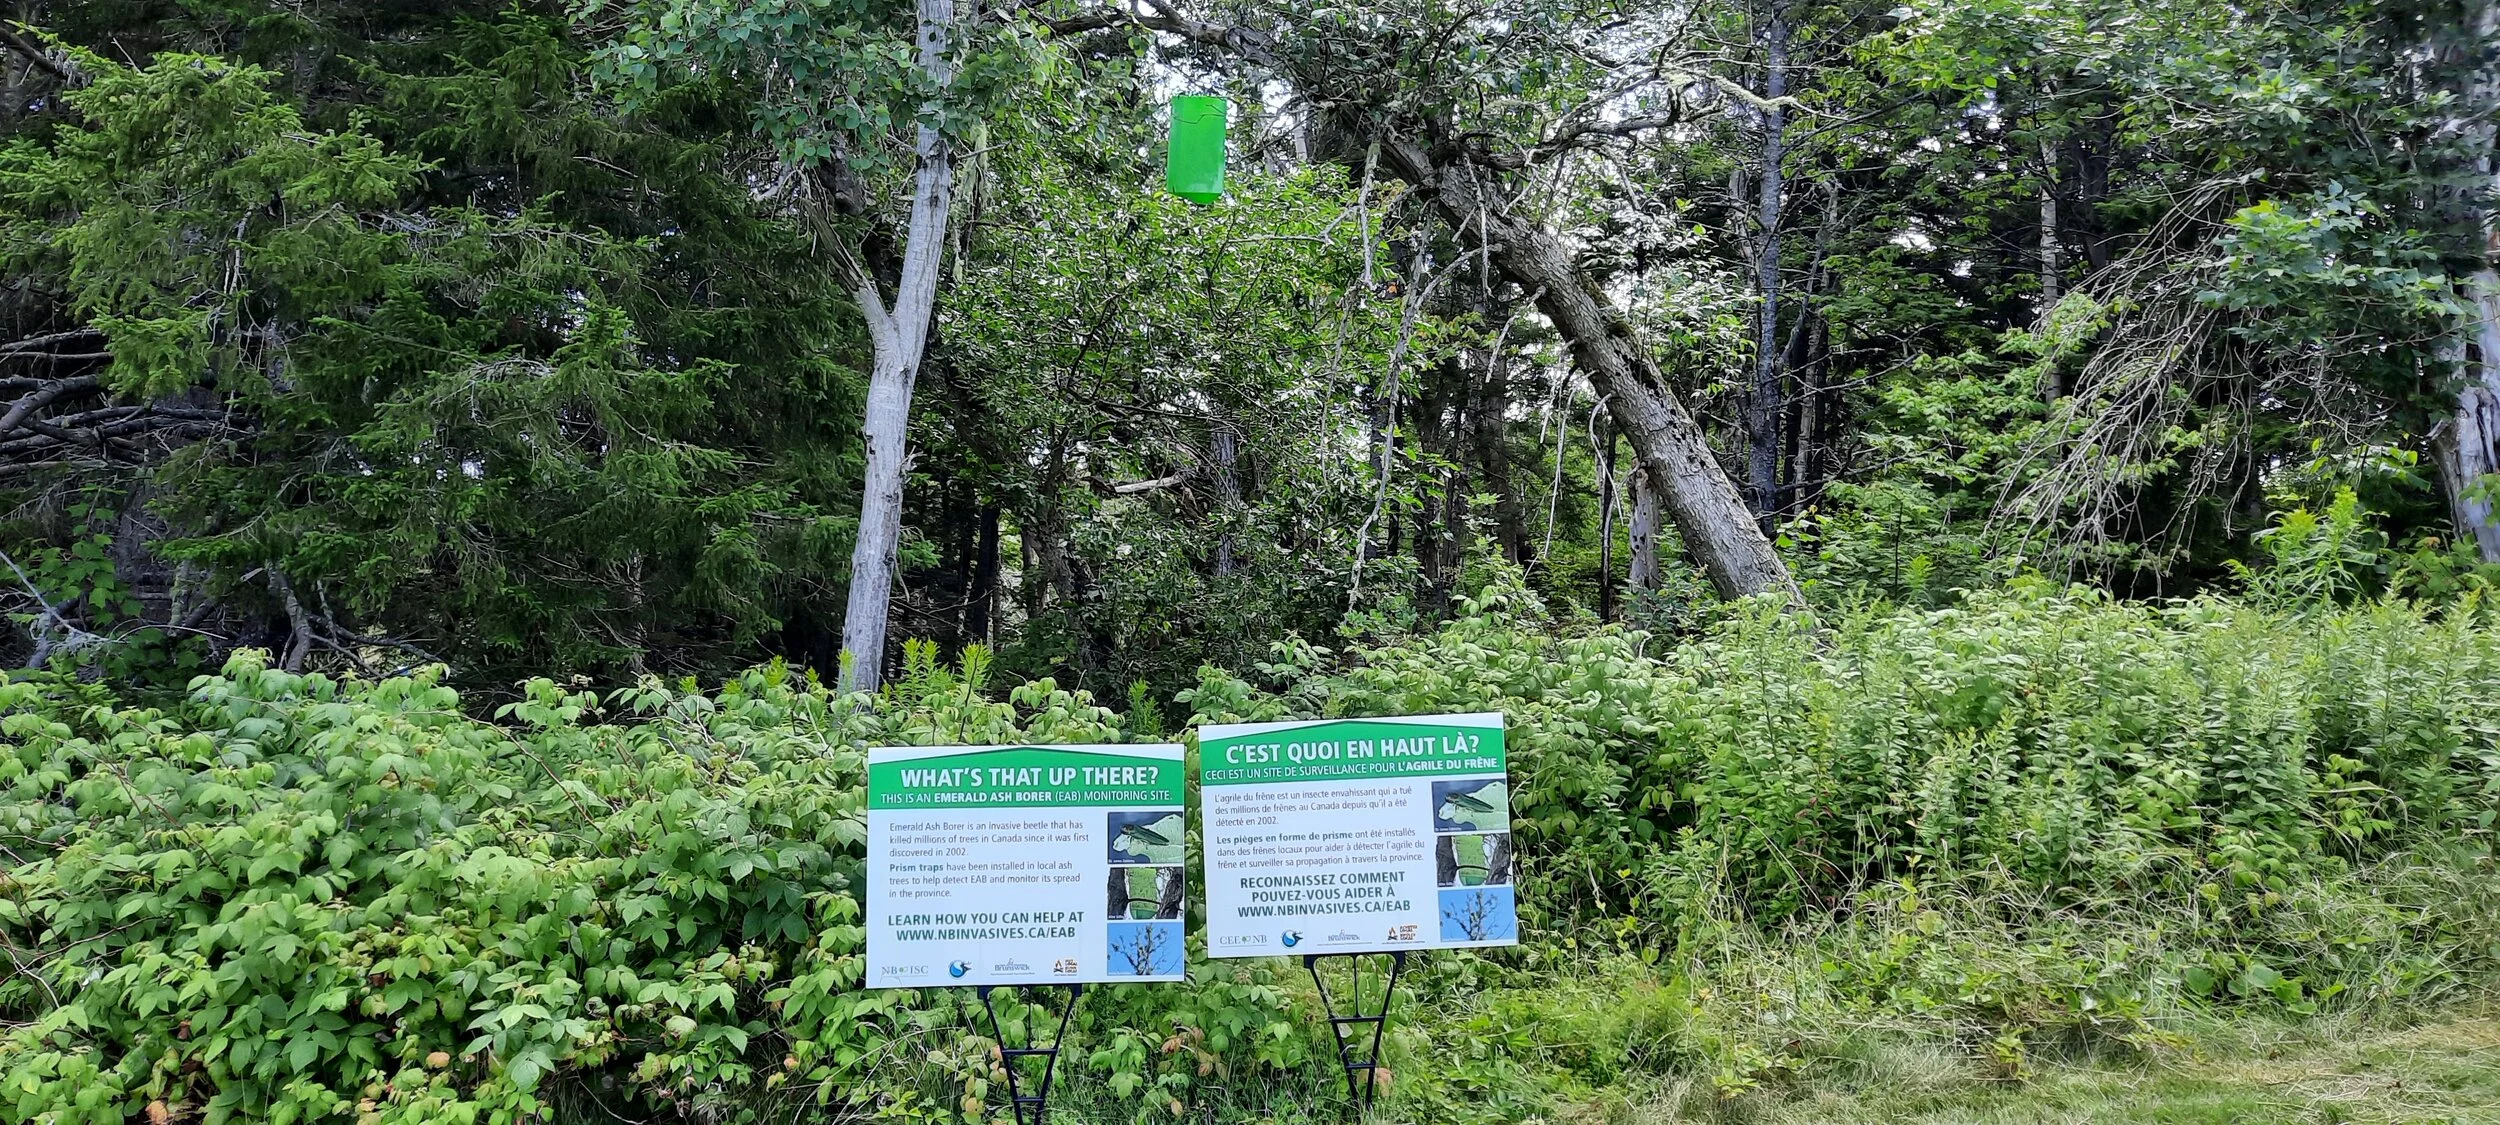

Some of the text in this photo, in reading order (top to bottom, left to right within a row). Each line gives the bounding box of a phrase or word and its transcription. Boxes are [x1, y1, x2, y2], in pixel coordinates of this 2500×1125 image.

[1226, 732, 1479, 764] C'EST QUOI EN HAUT LÀ?
[1206, 756, 1499, 780] CECI EST UN SITE DE SURVEILLANCE POUR L'AGRILE DU FRÊNE.
[901, 767, 1158, 788] WHAT'S THAT UP THERE?
[881, 790, 1172, 803] THIS IS AN EMERALD ASH BORER (EAB) MONITORING SITE.
[1244, 793, 1253, 801] du
[1256, 793, 1275, 801] frêne
[1303, 791, 1328, 799] insecte
[1331, 788, 1376, 798] envahissant
[1378, 788, 1390, 796] qui
[1400, 787, 1412, 795] tué
[1215, 806, 1228, 814] des
[1231, 806, 1259, 814] millions
[1262, 805, 1271, 813] de
[1274, 804, 1296, 812] frênes
[1311, 802, 1340, 811] Canada
[1342, 801, 1367, 811] depuis
[890, 822, 923, 832] Emerald
[925, 823, 940, 831] Ash
[943, 823, 964, 831] Borer
[967, 822, 973, 830] is
[989, 822, 1021, 830] invasive
[1024, 821, 1048, 830] beetle
[1069, 820, 1083, 829] has
[1216, 818, 1244, 826] détecté
[1258, 817, 1278, 825] 2002.
[890, 836, 911, 844] killed
[914, 835, 946, 843] millions
[949, 835, 957, 843] of
[959, 835, 979, 843] trees
[982, 835, 988, 843] in
[992, 834, 1022, 843] Canada
[1024, 834, 1044, 842] since
[1048, 834, 1052, 842] it
[1074, 833, 1089, 842] first
[1217, 836, 1231, 844] Les
[1234, 835, 1263, 845] pièges
[1279, 833, 1306, 842] forme
[1309, 832, 1320, 840] de
[1322, 831, 1352, 841] prisme
[1370, 830, 1382, 838] été
[1385, 828, 1415, 837] installés
[890, 848, 968, 857] discovered in 2002.
[1253, 847, 1276, 855] frênes
[1278, 845, 1303, 854] locaux
[1305, 845, 1322, 854] pour
[1325, 843, 1344, 852] aider
[1354, 841, 1384, 850] détecter
[1415, 840, 1424, 848] du
[890, 861, 1072, 873] Prism traps have been installed in local ash
[1218, 861, 1237, 869] frêne
[1249, 858, 1283, 867] surveiller
[1296, 855, 1342, 867] propagation
[1352, 855, 1378, 863] travers
[1380, 854, 1387, 862] la
[1390, 852, 1424, 862] province.
[890, 873, 1080, 886] trees to help detect EAB and monitor its spread
[1240, 871, 1405, 889] RECONNAISSEZ COMMENT
[915, 889, 951, 899] province.
[1252, 883, 1396, 903] POUVEZ-VOUS AIDER À
[1238, 900, 1410, 917] WWW.NBINVASIVES.CA/EAB
[888, 912, 1084, 926] LEARN HOW YOU CAN HELP AT
[896, 927, 1075, 941] WWW.NBINVASIVES.CA/EAB
[881, 966, 928, 974] NB ISC
